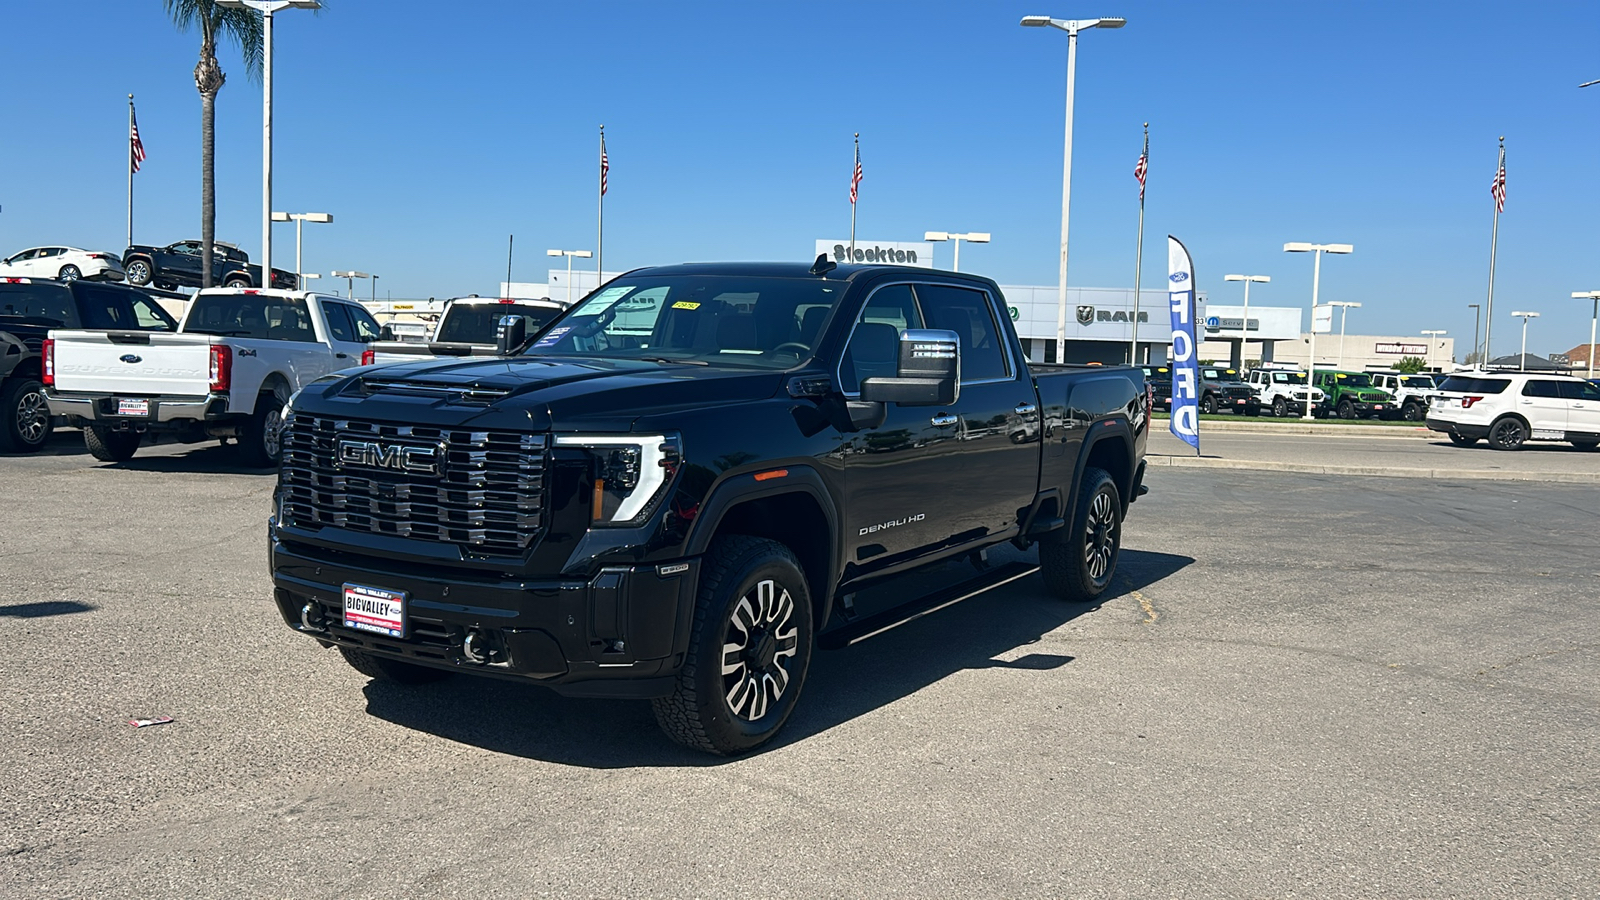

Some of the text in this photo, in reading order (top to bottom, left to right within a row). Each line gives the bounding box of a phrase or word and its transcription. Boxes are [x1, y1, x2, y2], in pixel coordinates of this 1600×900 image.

[833, 244, 917, 263] Stockton
[1097, 310, 1148, 323] RAM
[1222, 319, 1254, 327] Servie
[62, 364, 200, 376] SUPER DUTY
[340, 440, 436, 472] GMC
[859, 513, 926, 536] DENALI HD
[347, 596, 390, 616] BIGVALLEY
[356, 622, 390, 635] STOCKTON
